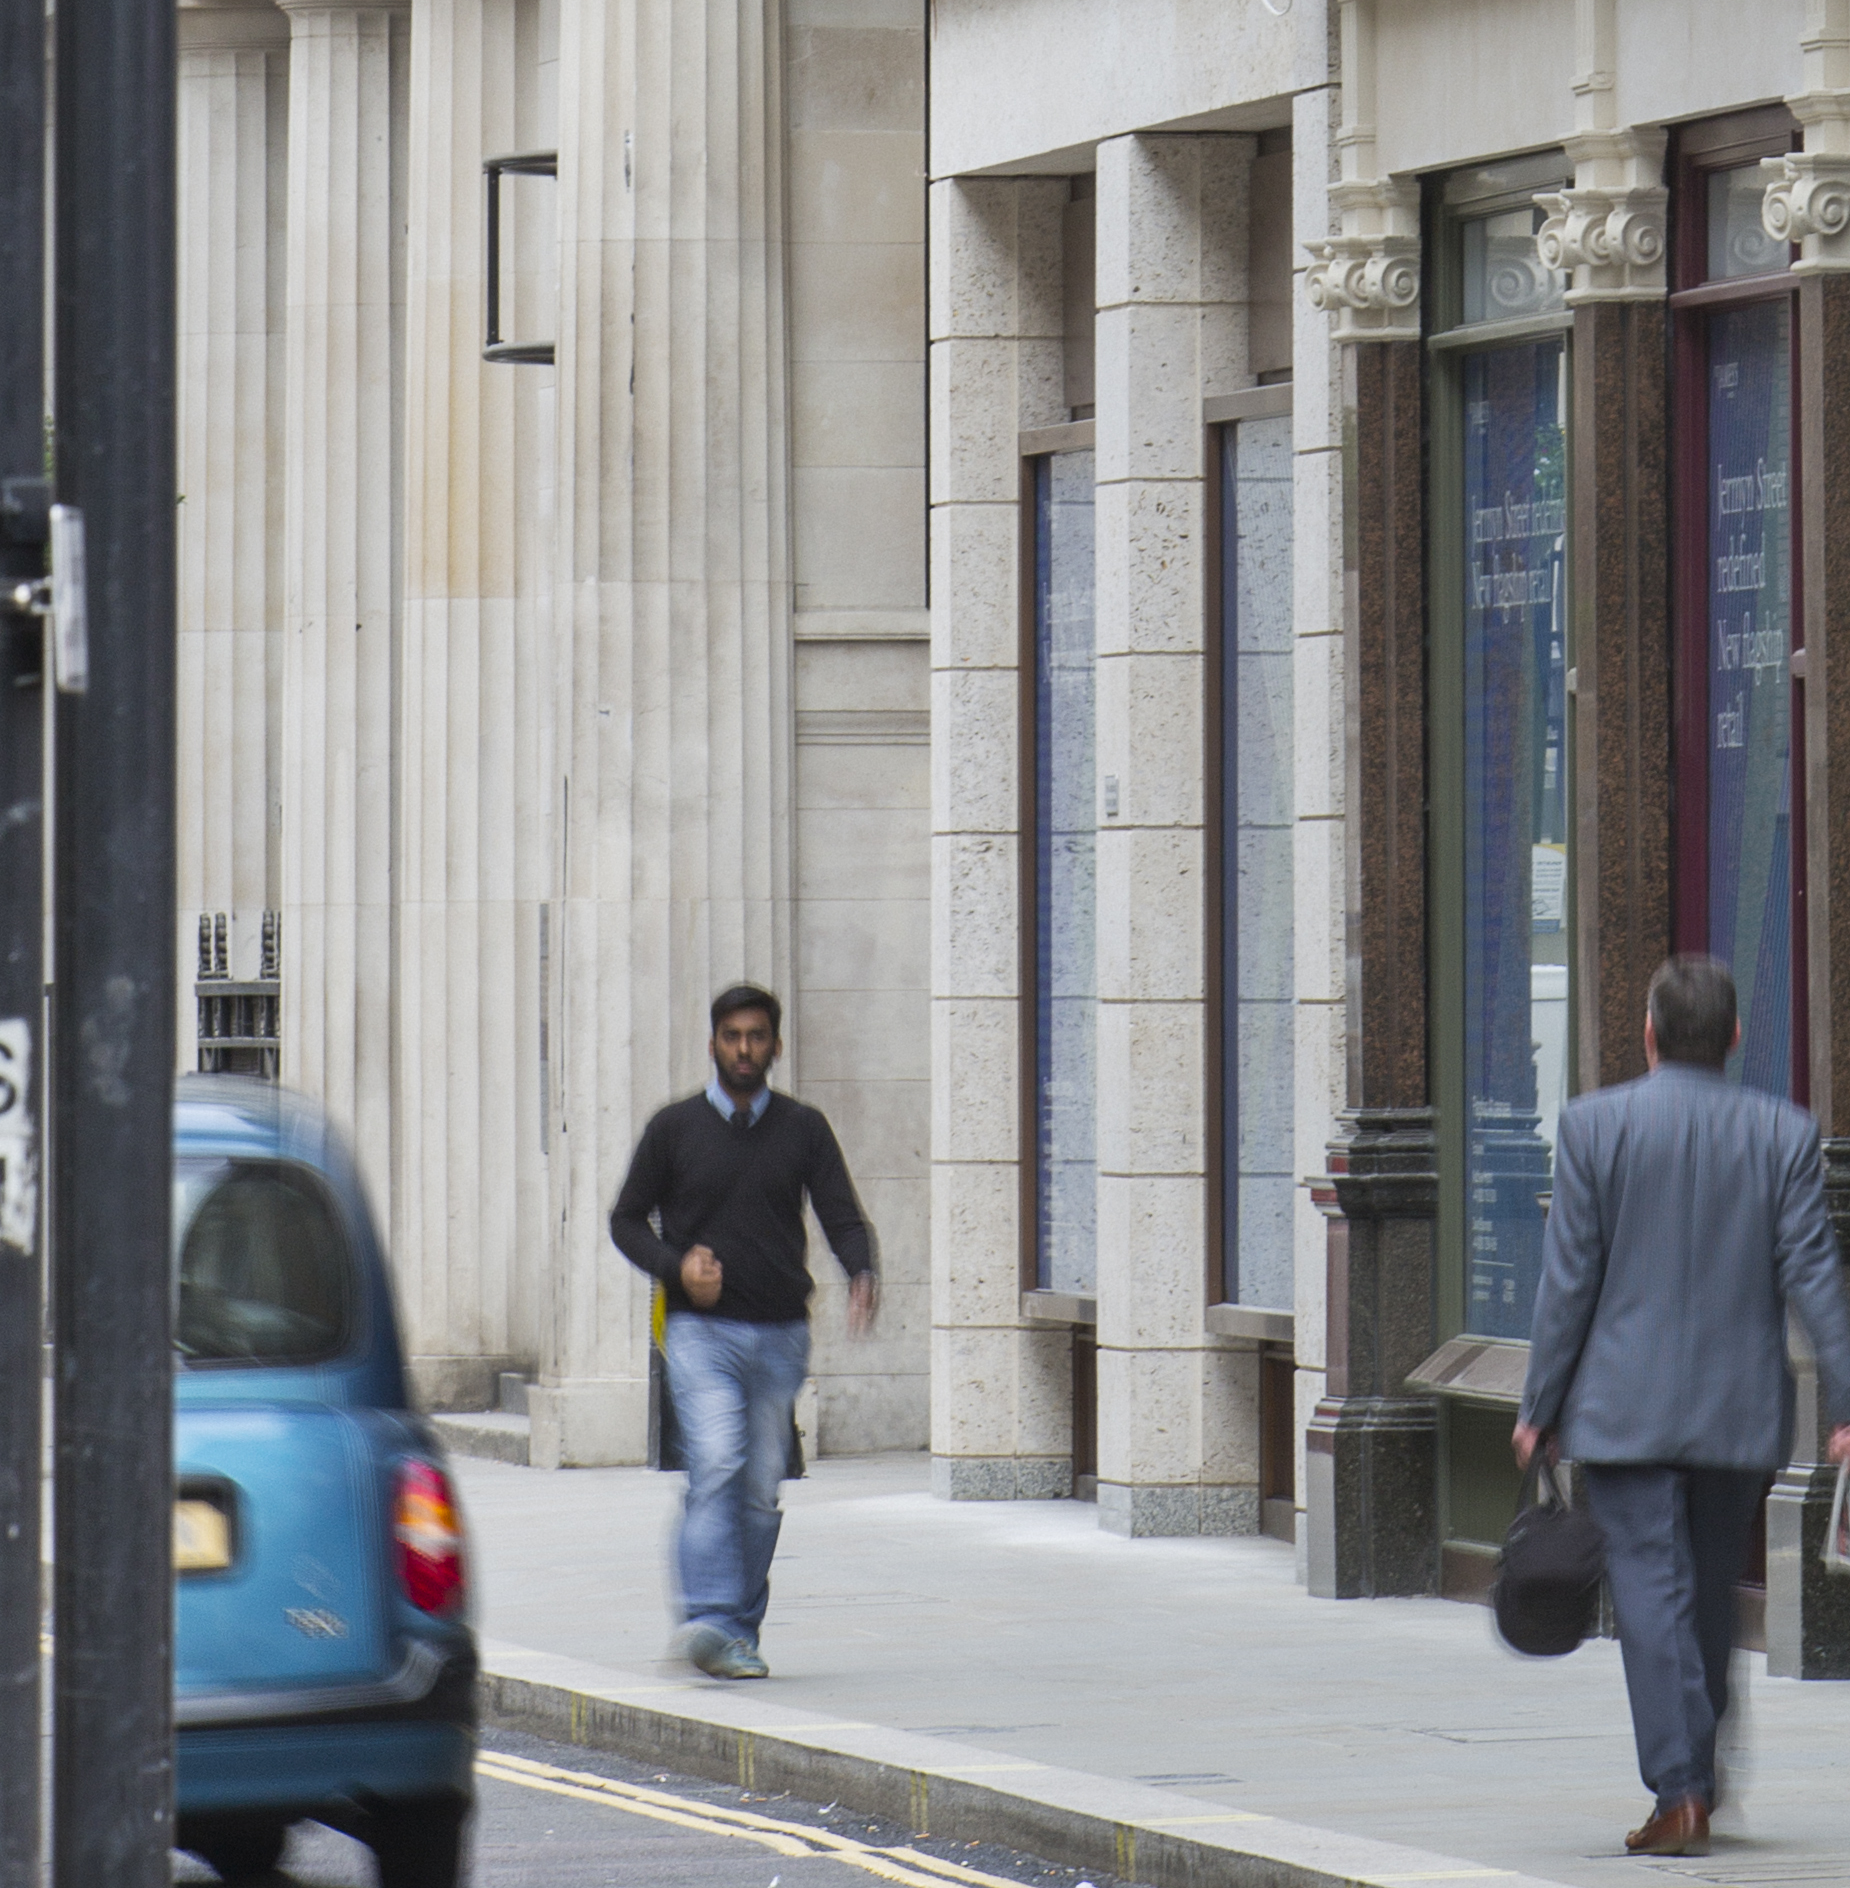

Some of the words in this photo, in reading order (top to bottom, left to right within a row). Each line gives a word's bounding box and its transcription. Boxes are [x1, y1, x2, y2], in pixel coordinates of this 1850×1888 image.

[1717, 464, 1754, 530] Jermyn
[1756, 457, 1787, 511] Street
[1717, 531, 1766, 593] redefined
[1717, 619, 1741, 671] New
[1742, 611, 1784, 686] flagship
[1717, 691, 1744, 747] retail
